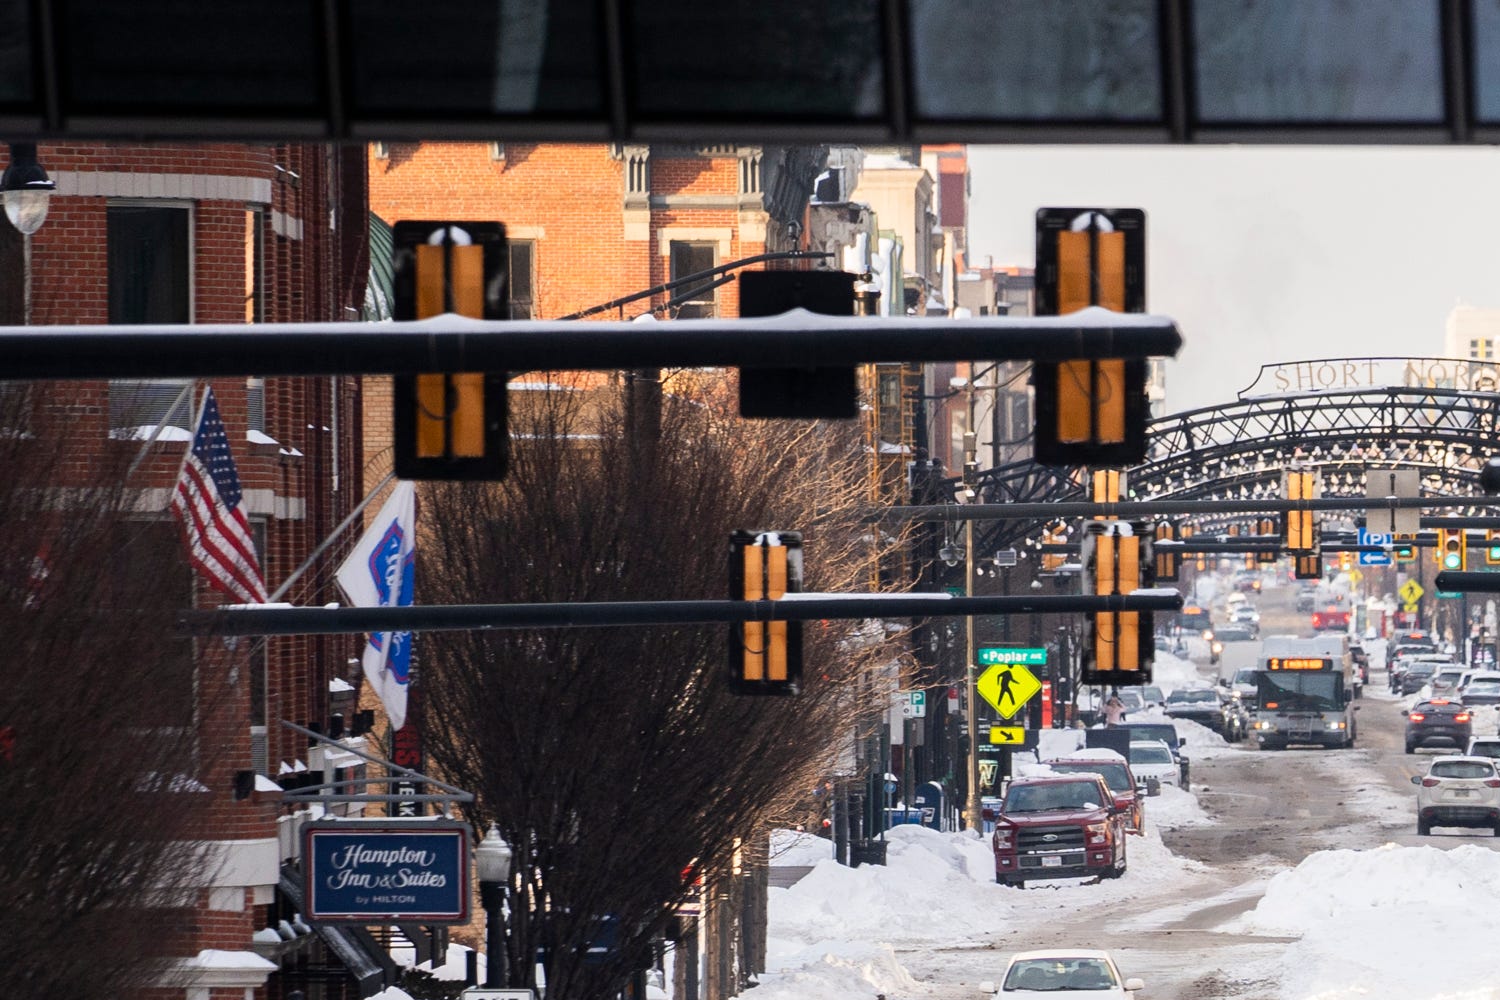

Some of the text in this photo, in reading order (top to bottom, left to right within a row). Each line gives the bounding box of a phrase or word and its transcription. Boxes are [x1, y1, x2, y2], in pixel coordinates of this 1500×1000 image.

[1274, 362, 1380, 389] SHORT
[990, 651, 1028, 664] Poplar
[912, 693, 923, 704] P
[331, 843, 436, 868] Hampton
[327, 868, 447, 890] Inn & Suites
[356, 895, 416, 904] by HILTON
